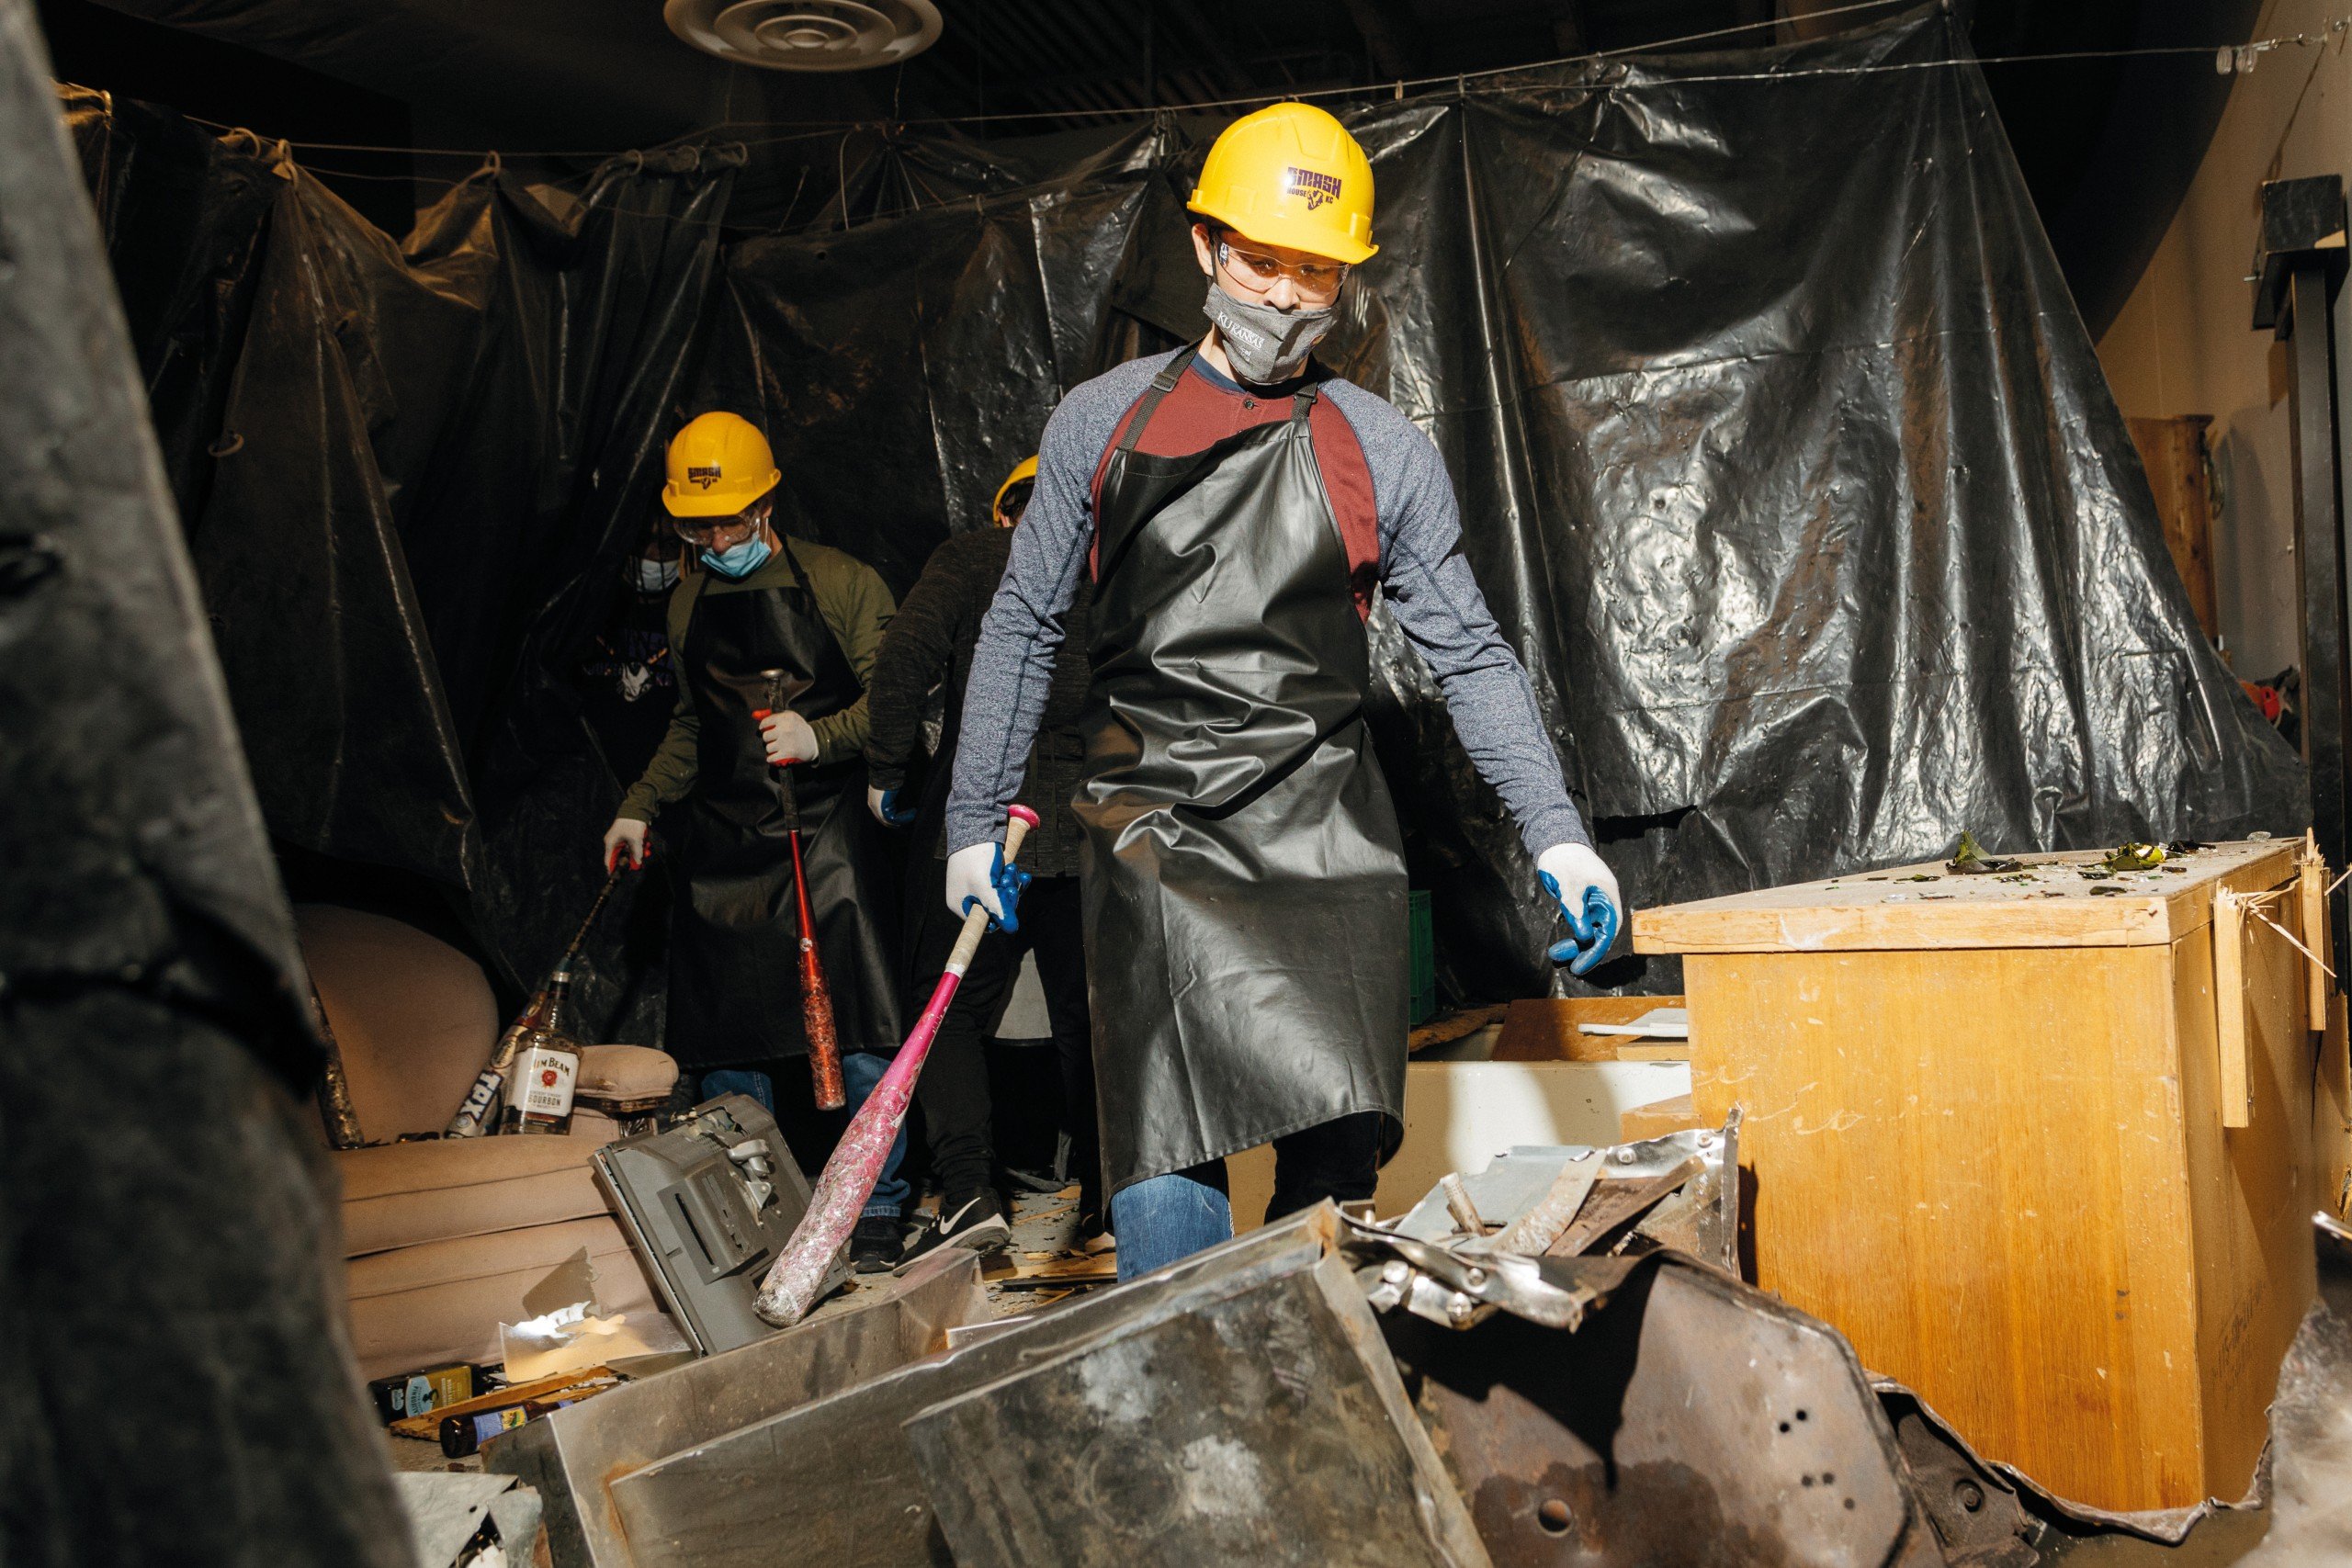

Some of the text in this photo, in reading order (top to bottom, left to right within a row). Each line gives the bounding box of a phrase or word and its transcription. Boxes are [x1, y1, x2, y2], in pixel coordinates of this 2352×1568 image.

[1286, 186, 1334, 204] HOUSE KC
[1287, 166, 1341, 200] SMASH
[1217, 311, 1265, 349] KU KANSAS
[688, 467, 722, 479] SMASH
[460, 1072, 502, 1120] TPX
